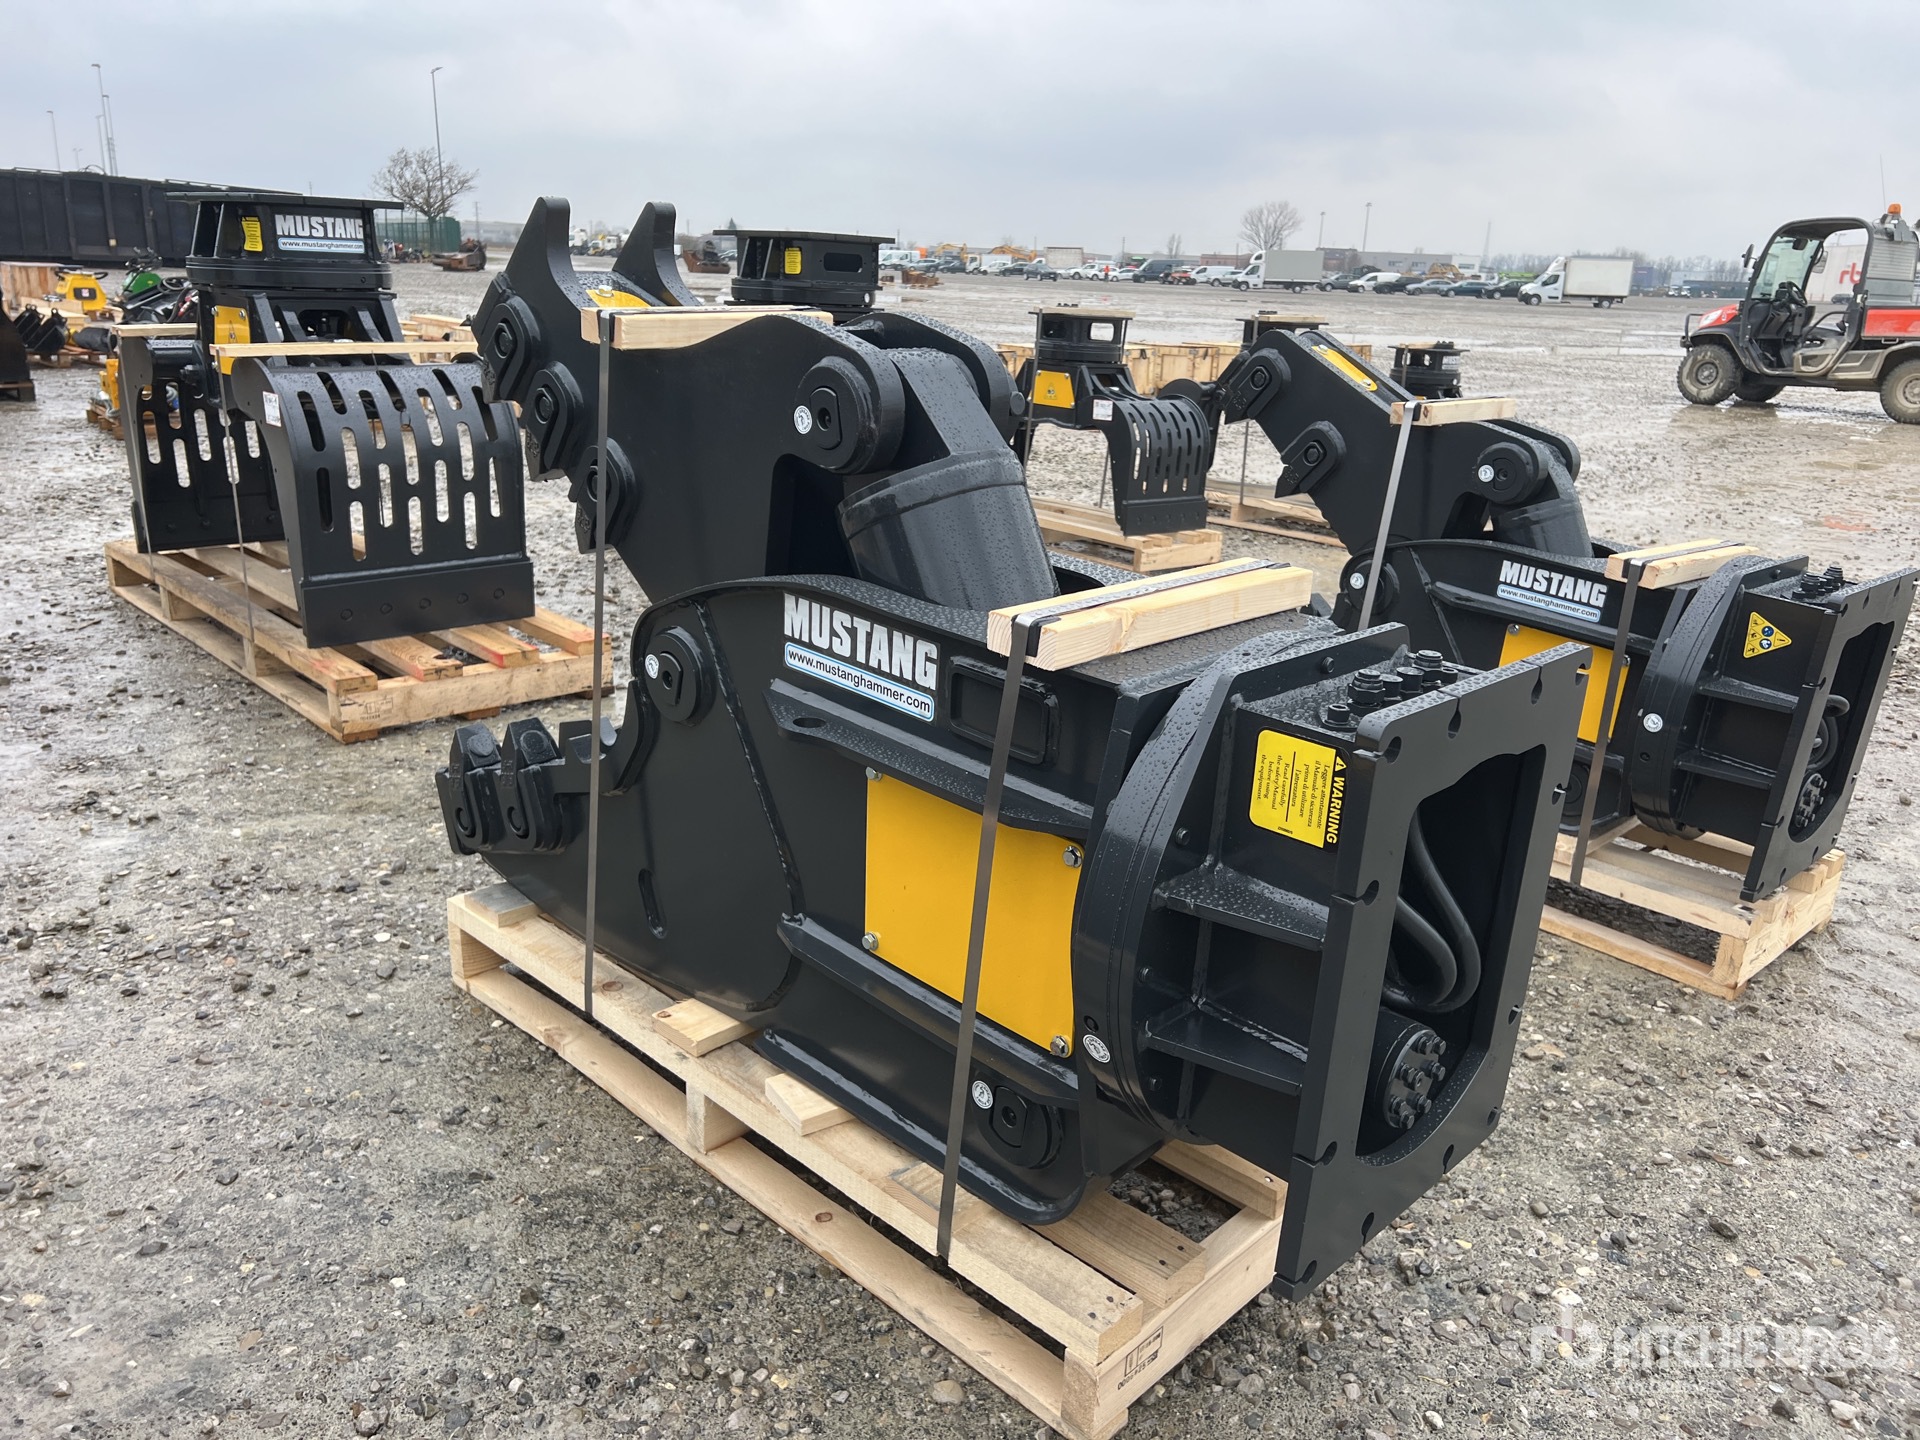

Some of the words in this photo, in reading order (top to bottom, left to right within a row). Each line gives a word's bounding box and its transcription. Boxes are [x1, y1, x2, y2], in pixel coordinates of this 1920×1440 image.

[275, 214, 363, 239] MUSTANG
[282, 240, 363, 250] www.mustanghammer.com
[1499, 560, 1608, 608] MUSTANG
[1500, 588, 1598, 618] www.mustanghammer.com
[784, 593, 938, 690] MUSTANG
[788, 650, 931, 713] www.mustanghammer.com
[1326, 776, 1345, 844] WARNING
